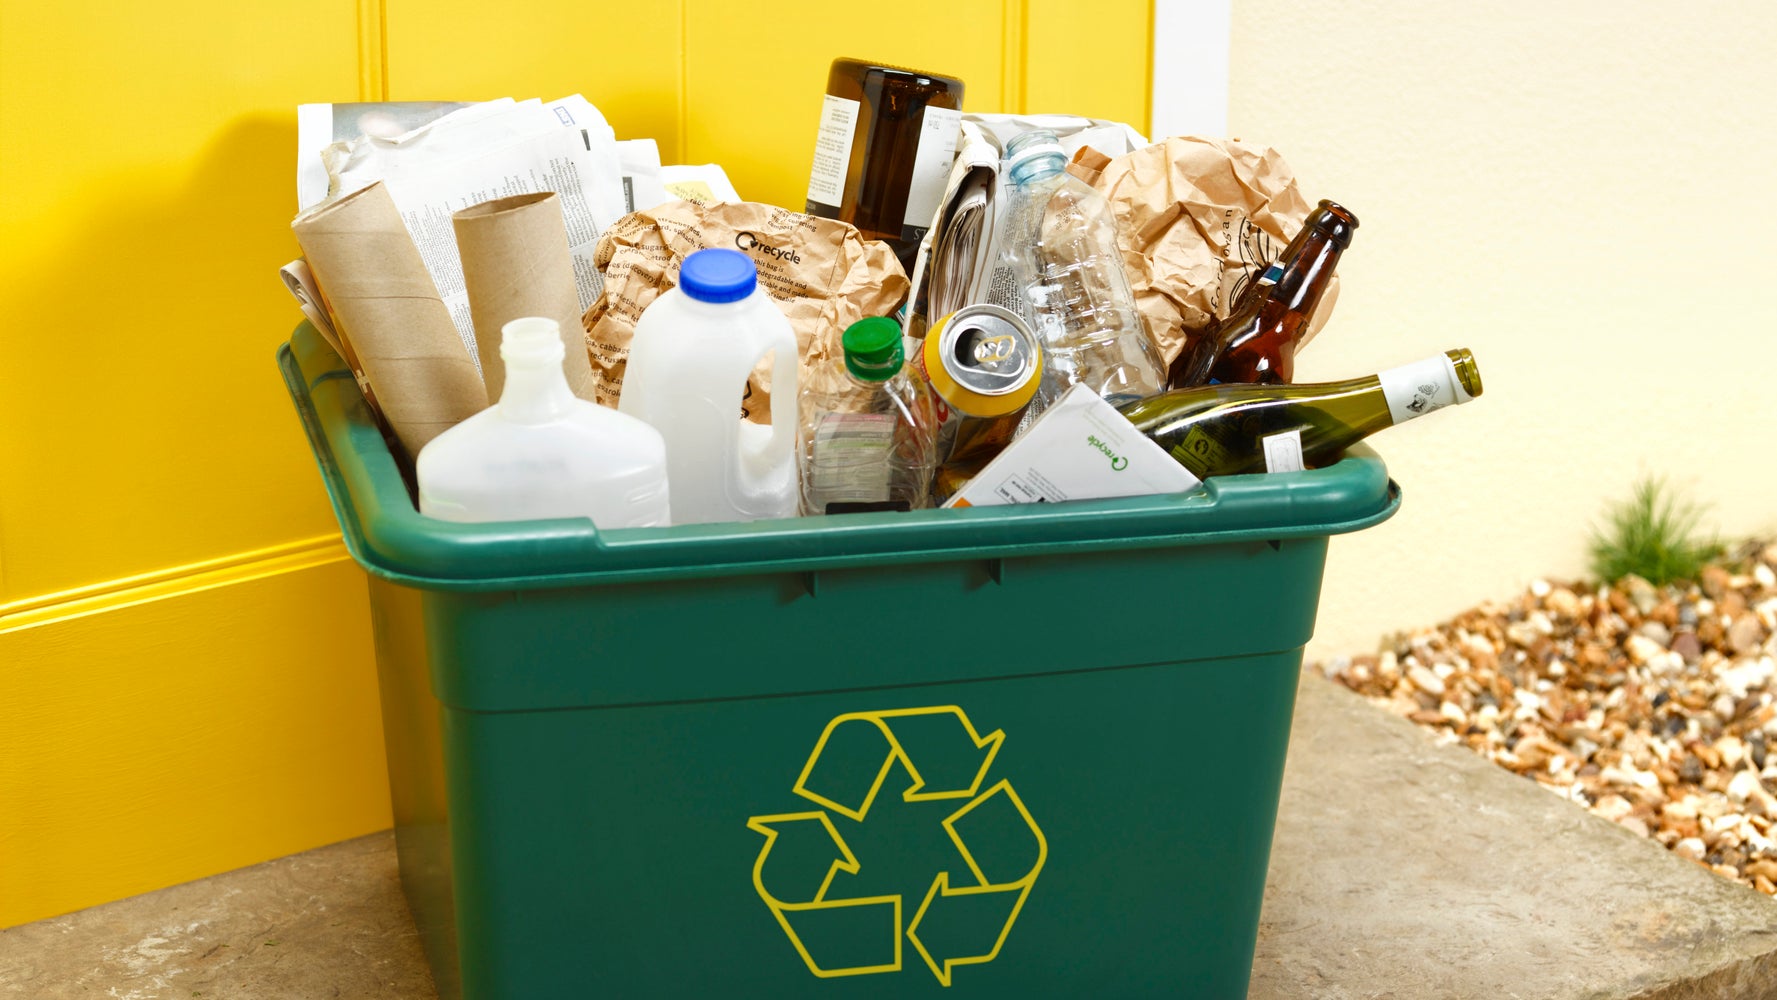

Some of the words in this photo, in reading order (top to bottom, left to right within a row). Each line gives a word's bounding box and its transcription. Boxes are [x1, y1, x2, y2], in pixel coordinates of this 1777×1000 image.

[758, 243, 800, 265] recycle
[767, 263, 777, 272] bag
[779, 286, 791, 294] and
[795, 282, 807, 290] and
[1088, 434, 1115, 458] recycle
